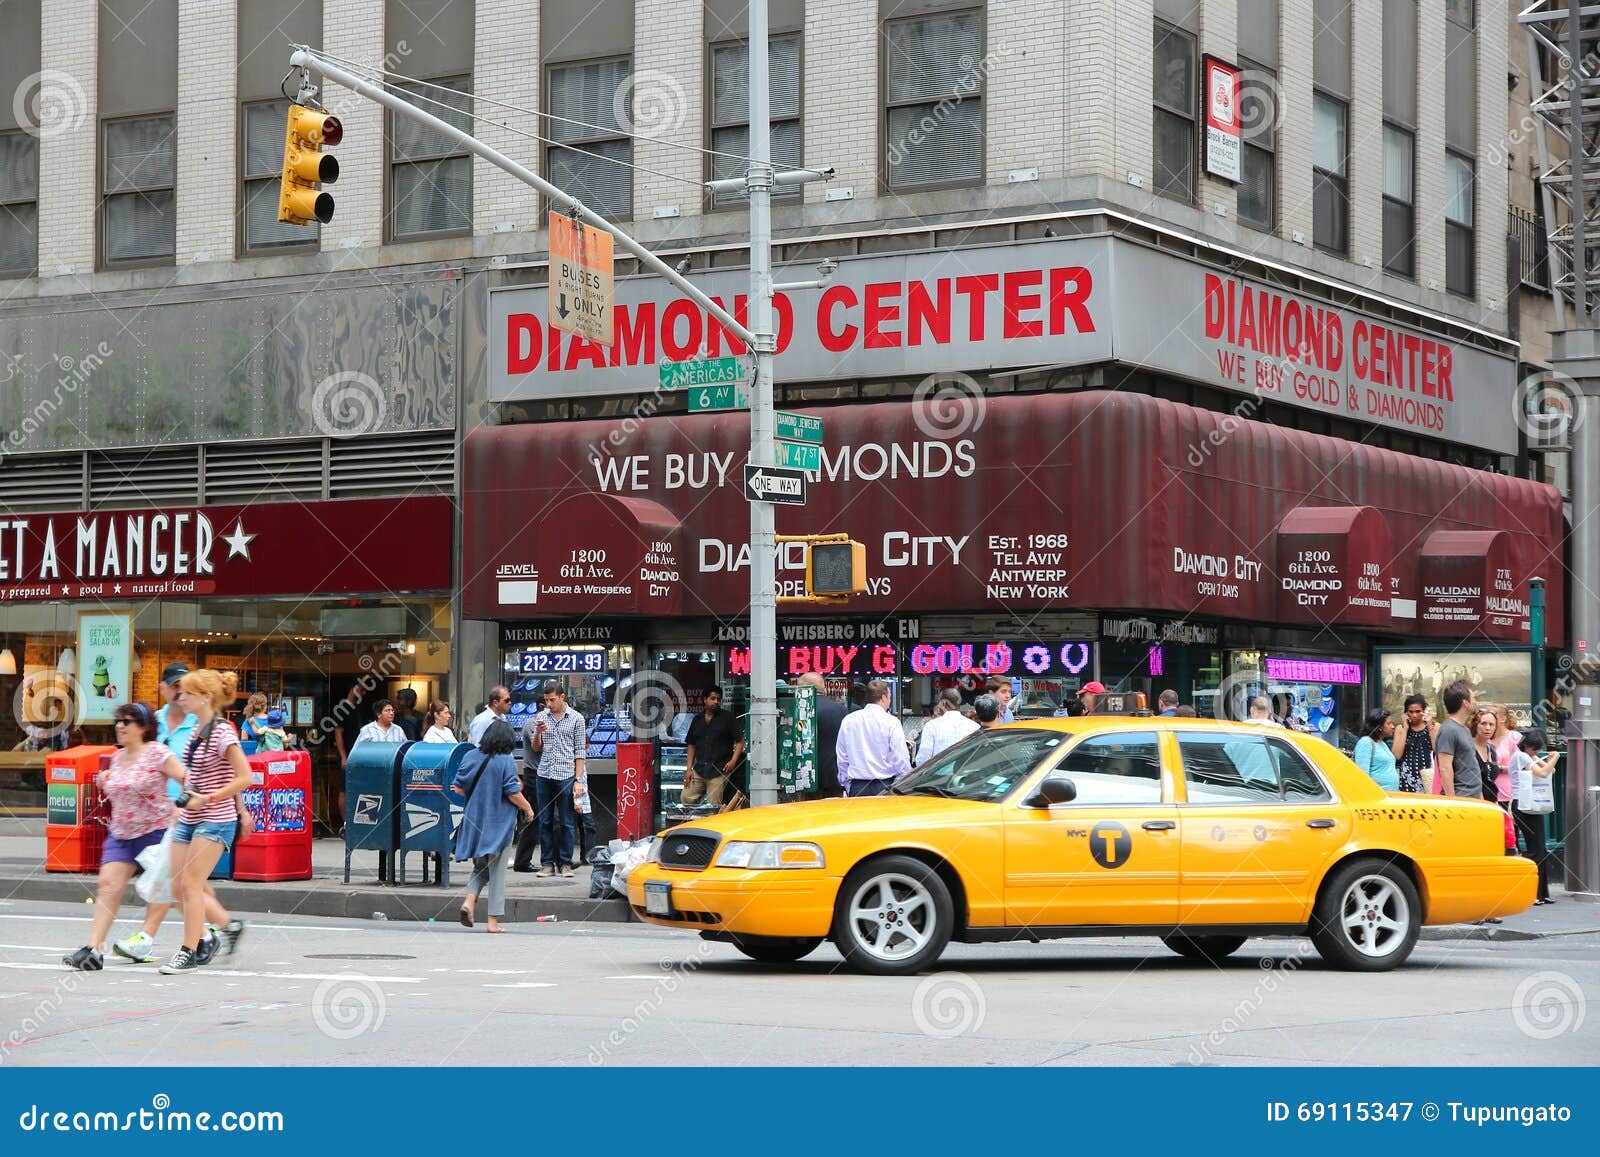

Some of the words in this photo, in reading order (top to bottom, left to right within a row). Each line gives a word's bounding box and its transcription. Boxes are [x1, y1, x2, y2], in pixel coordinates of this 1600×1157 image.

[562, 263, 600, 290] BUSES
[574, 297, 604, 319] ONLY
[817, 266, 1096, 352] CENTER
[1205, 272, 1344, 373] DIAMOND
[1352, 319, 1454, 403] CENTER
[671, 366, 734, 386] AMERICAS
[699, 388, 711, 408] 6
[716, 387, 729, 398] AV
[1217, 349, 1246, 385] WE
[1255, 361, 1284, 393] BUY
[1293, 371, 1340, 407] GOLD
[1349, 384, 1359, 411] &
[1367, 389, 1444, 432] DIAMONDS
[777, 414, 797, 426] DIAMOND
[799, 417, 820, 430] JEWELRY
[794, 446, 807, 466] 47
[809, 447, 817, 458] ST
[594, 455, 649, 491] WE
[665, 452, 735, 489] BUY
[755, 477, 772, 491] ONE
[780, 480, 798, 493] WAY
[39, 519, 59, 578] A
[76, 511, 215, 578] MANGER
[651, 541, 672, 553] 1200
[988, 535, 1021, 549] EST.
[1028, 534, 1068, 548] 1968
[883, 531, 970, 567] CITY
[571, 550, 606, 563] 1200
[645, 553, 659, 565] 6th
[660, 554, 676, 565] Ave.
[993, 551, 1023, 565] TEL
[1026, 551, 1062, 565] AVIV
[1298, 551, 1330, 562] 1200
[496, 564, 538, 574] JEWEL
[560, 564, 583, 578] 6th
[586, 564, 614, 578] Ave.
[1174, 547, 1228, 577] DIAMOND
[1235, 555, 1262, 582] CITY
[1288, 562, 1310, 574] 6th
[1312, 563, 1338, 574] Ave.
[1363, 563, 1380, 576] 1200
[640, 568, 679, 581] DIAMOND
[989, 568, 1066, 581] ANTWERP
[1497, 569, 1504, 580] 77
[9, 585, 51, 599] prepared
[79, 584, 103, 597] good
[132, 582, 168, 593] natural
[172, 581, 194, 592] food
[541, 585, 572, 594] LADER
[574, 585, 581, 594] &
[583, 585, 631, 594] WEISBERG
[650, 584, 670, 596] CITY
[987, 584, 1023, 598] NEW
[1026, 584, 1069, 598] YORK
[1198, 581, 1216, 596] OPEN
[1222, 584, 1239, 598] DAYS
[1282, 578, 1342, 590] DIAMOND
[1358, 577, 1369, 590] 6th
[1370, 579, 1383, 591] Ave.
[1424, 586, 1480, 596] MALIDANI
[1298, 593, 1328, 605] CITY
[1486, 596, 1522, 612] MALIDANI
[89, 628, 102, 638] GET
[104, 628, 121, 638] YOUR
[505, 628, 547, 641] MERIK
[552, 627, 613, 640] JEWELRY
[782, 624, 854, 640] WEISBERG
[860, 622, 890, 639] INC.
[898, 619, 919, 639] EN
[89, 638, 110, 647] SALAD
[112, 638, 121, 647] ON
[789, 646, 859, 674] BUY
[872, 646, 896, 674] G
[911, 644, 1013, 674] GOLD
[50, 796, 76, 807] metro
[272, 792, 300, 805] VOICE
[1354, 808, 1380, 821] 1F59
[1066, 829, 1087, 838] NYC
[1098, 829, 1122, 863] T
